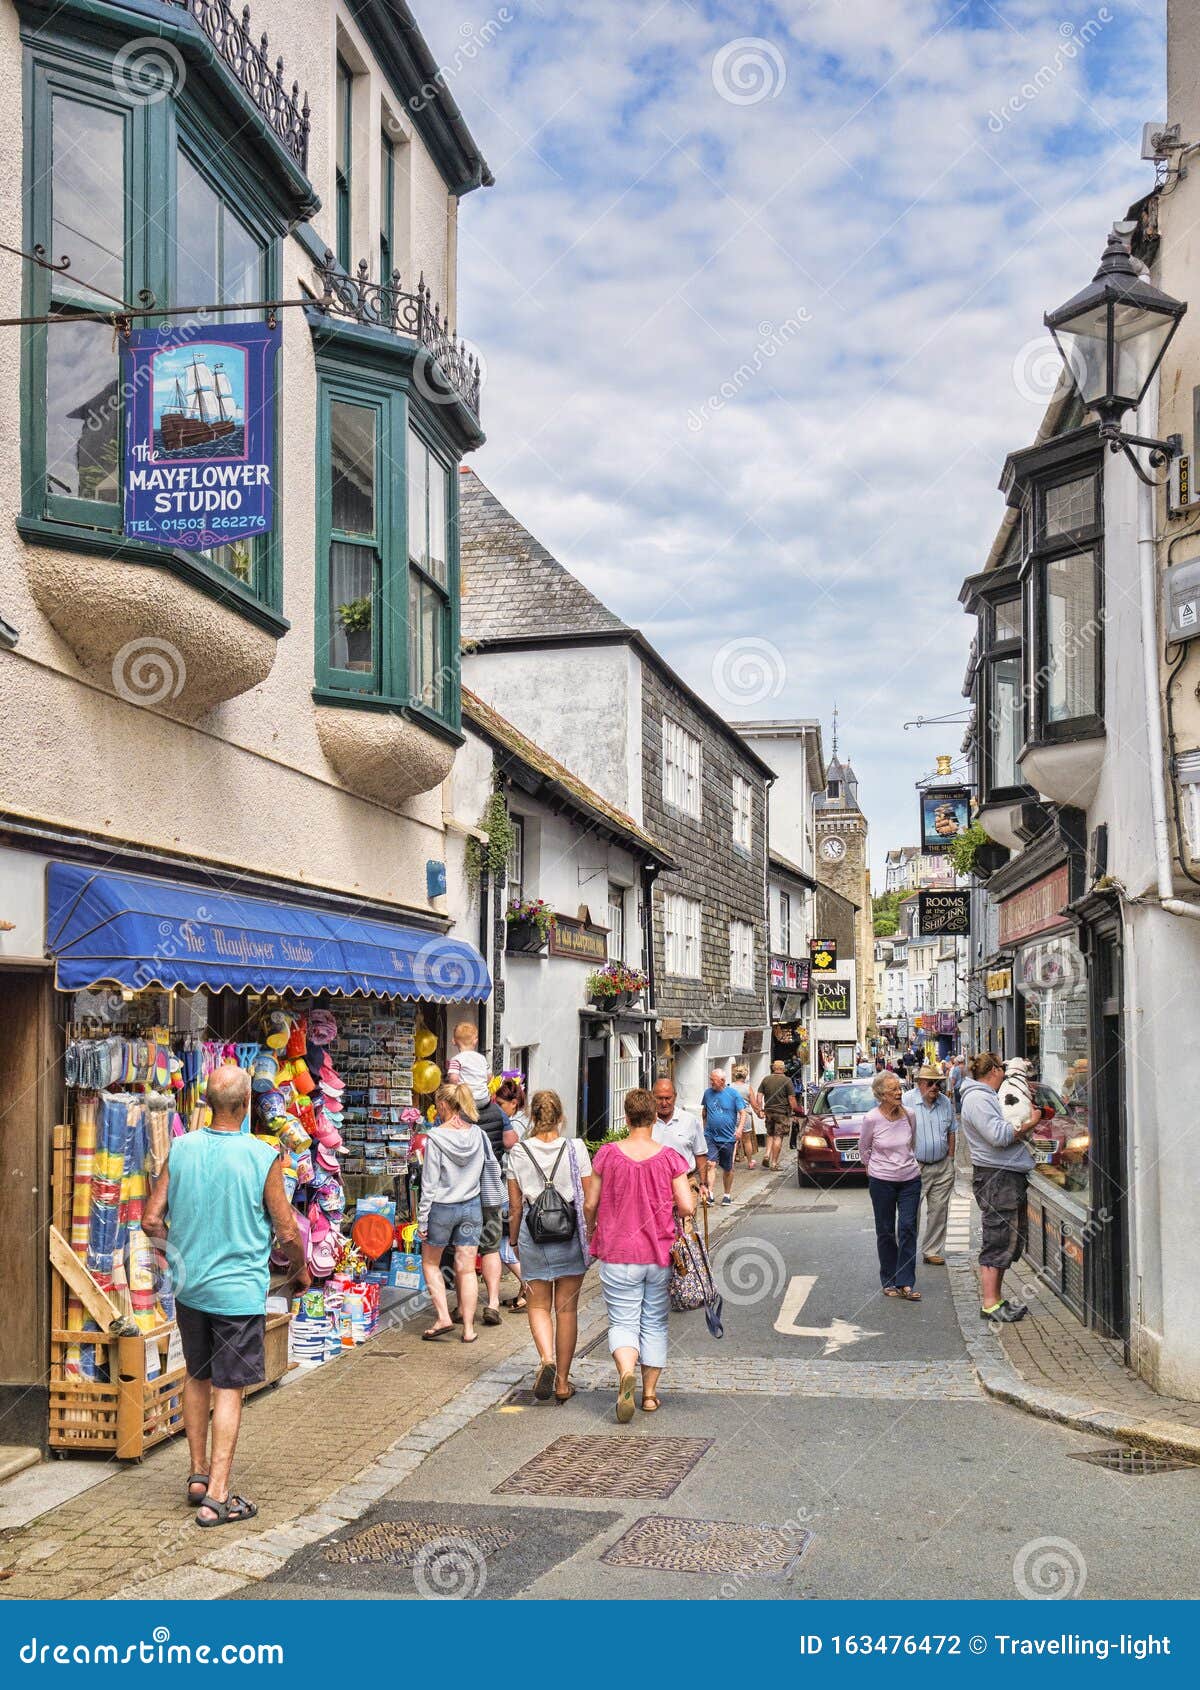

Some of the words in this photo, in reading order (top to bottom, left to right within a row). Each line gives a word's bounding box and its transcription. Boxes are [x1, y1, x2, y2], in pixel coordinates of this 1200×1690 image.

[132, 438, 159, 463] The
[129, 465, 271, 491] MAYFLOWER
[1180, 458, 1188, 504] C086
[154, 490, 242, 513] STUDIO
[130, 520, 157, 531] TEL.
[161, 517, 206, 530] 01503
[211, 515, 266, 529] 262276
[925, 897, 964, 907] ROOMS
[924, 915, 945, 930] SHIP
[947, 907, 964, 919] INN
[182, 921, 206, 953] The
[210, 927, 275, 964] Mayflower
[279, 936, 314, 963] Studio
